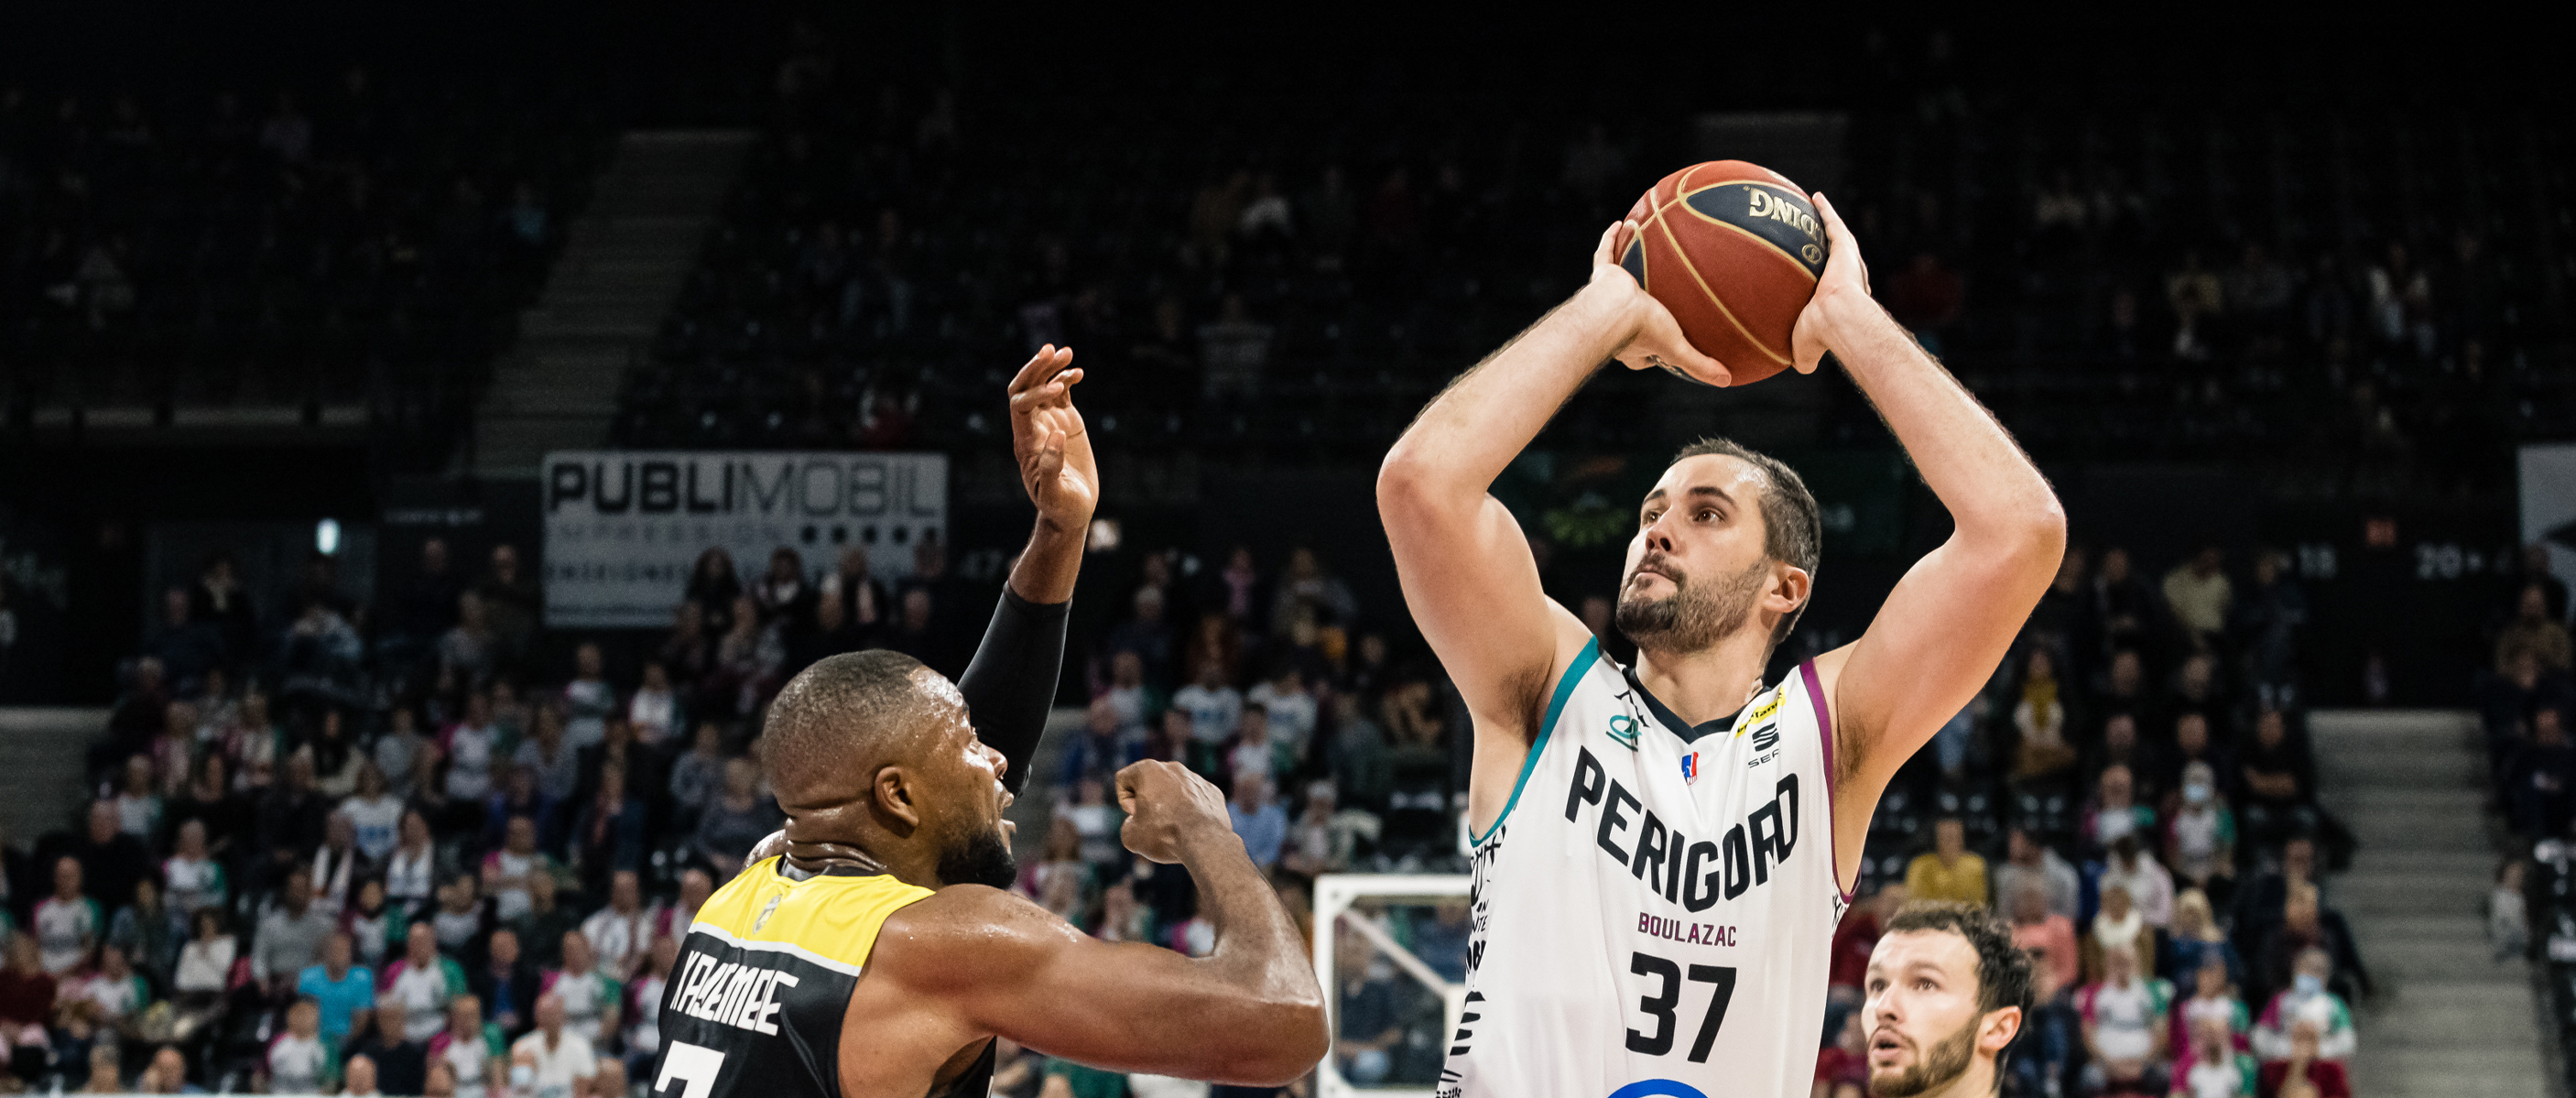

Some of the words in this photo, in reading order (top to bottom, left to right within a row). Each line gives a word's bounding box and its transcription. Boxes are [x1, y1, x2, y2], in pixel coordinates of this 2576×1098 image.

[549, 462, 937, 517] PUBLIMOBIL
[1565, 745, 1799, 913] PERIGORD
[1637, 911, 1737, 947] BOULAZAC
[1625, 951, 1737, 1064] 37
